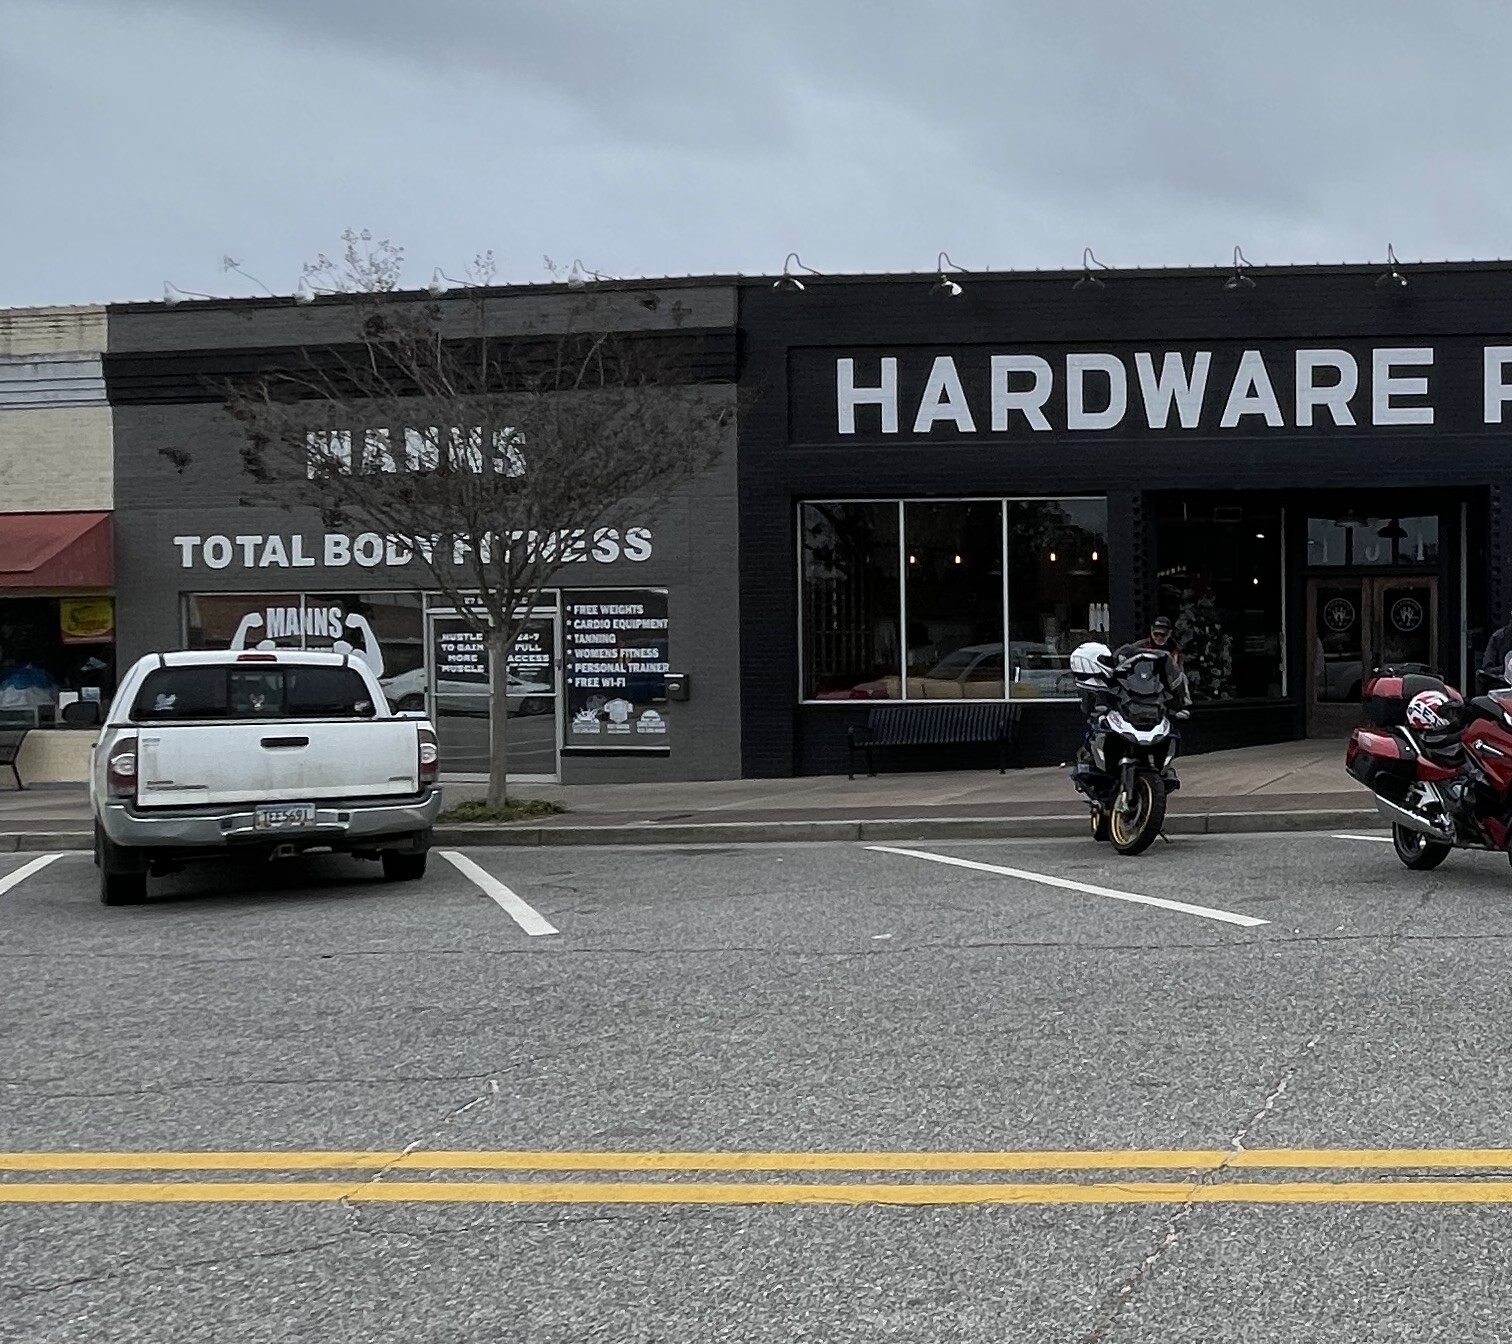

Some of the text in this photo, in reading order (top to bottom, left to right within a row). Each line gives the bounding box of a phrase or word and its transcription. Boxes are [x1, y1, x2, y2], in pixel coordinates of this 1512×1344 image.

[837, 345, 1435, 436] HARDWARE
[306, 426, 527, 479] MANNS
[173, 534, 315, 569] TOTAL
[323, 532, 441, 567] BODY
[573, 604, 644, 614] FREE WEIGHTS
[266, 607, 343, 639] MANNS
[574, 619, 668, 630] CARDIO EQUIPMENT
[574, 634, 616, 644] TANNING
[441, 644, 455, 652] TO
[514, 644, 542, 652] FULL
[574, 648, 659, 658] WOMENS FITNESS
[447, 654, 479, 662] MORE
[507, 654, 550, 662] ACCESS
[575, 663, 669, 673] PERSONAL TRAINER
[575, 677, 626, 687] FREE WI-FI
